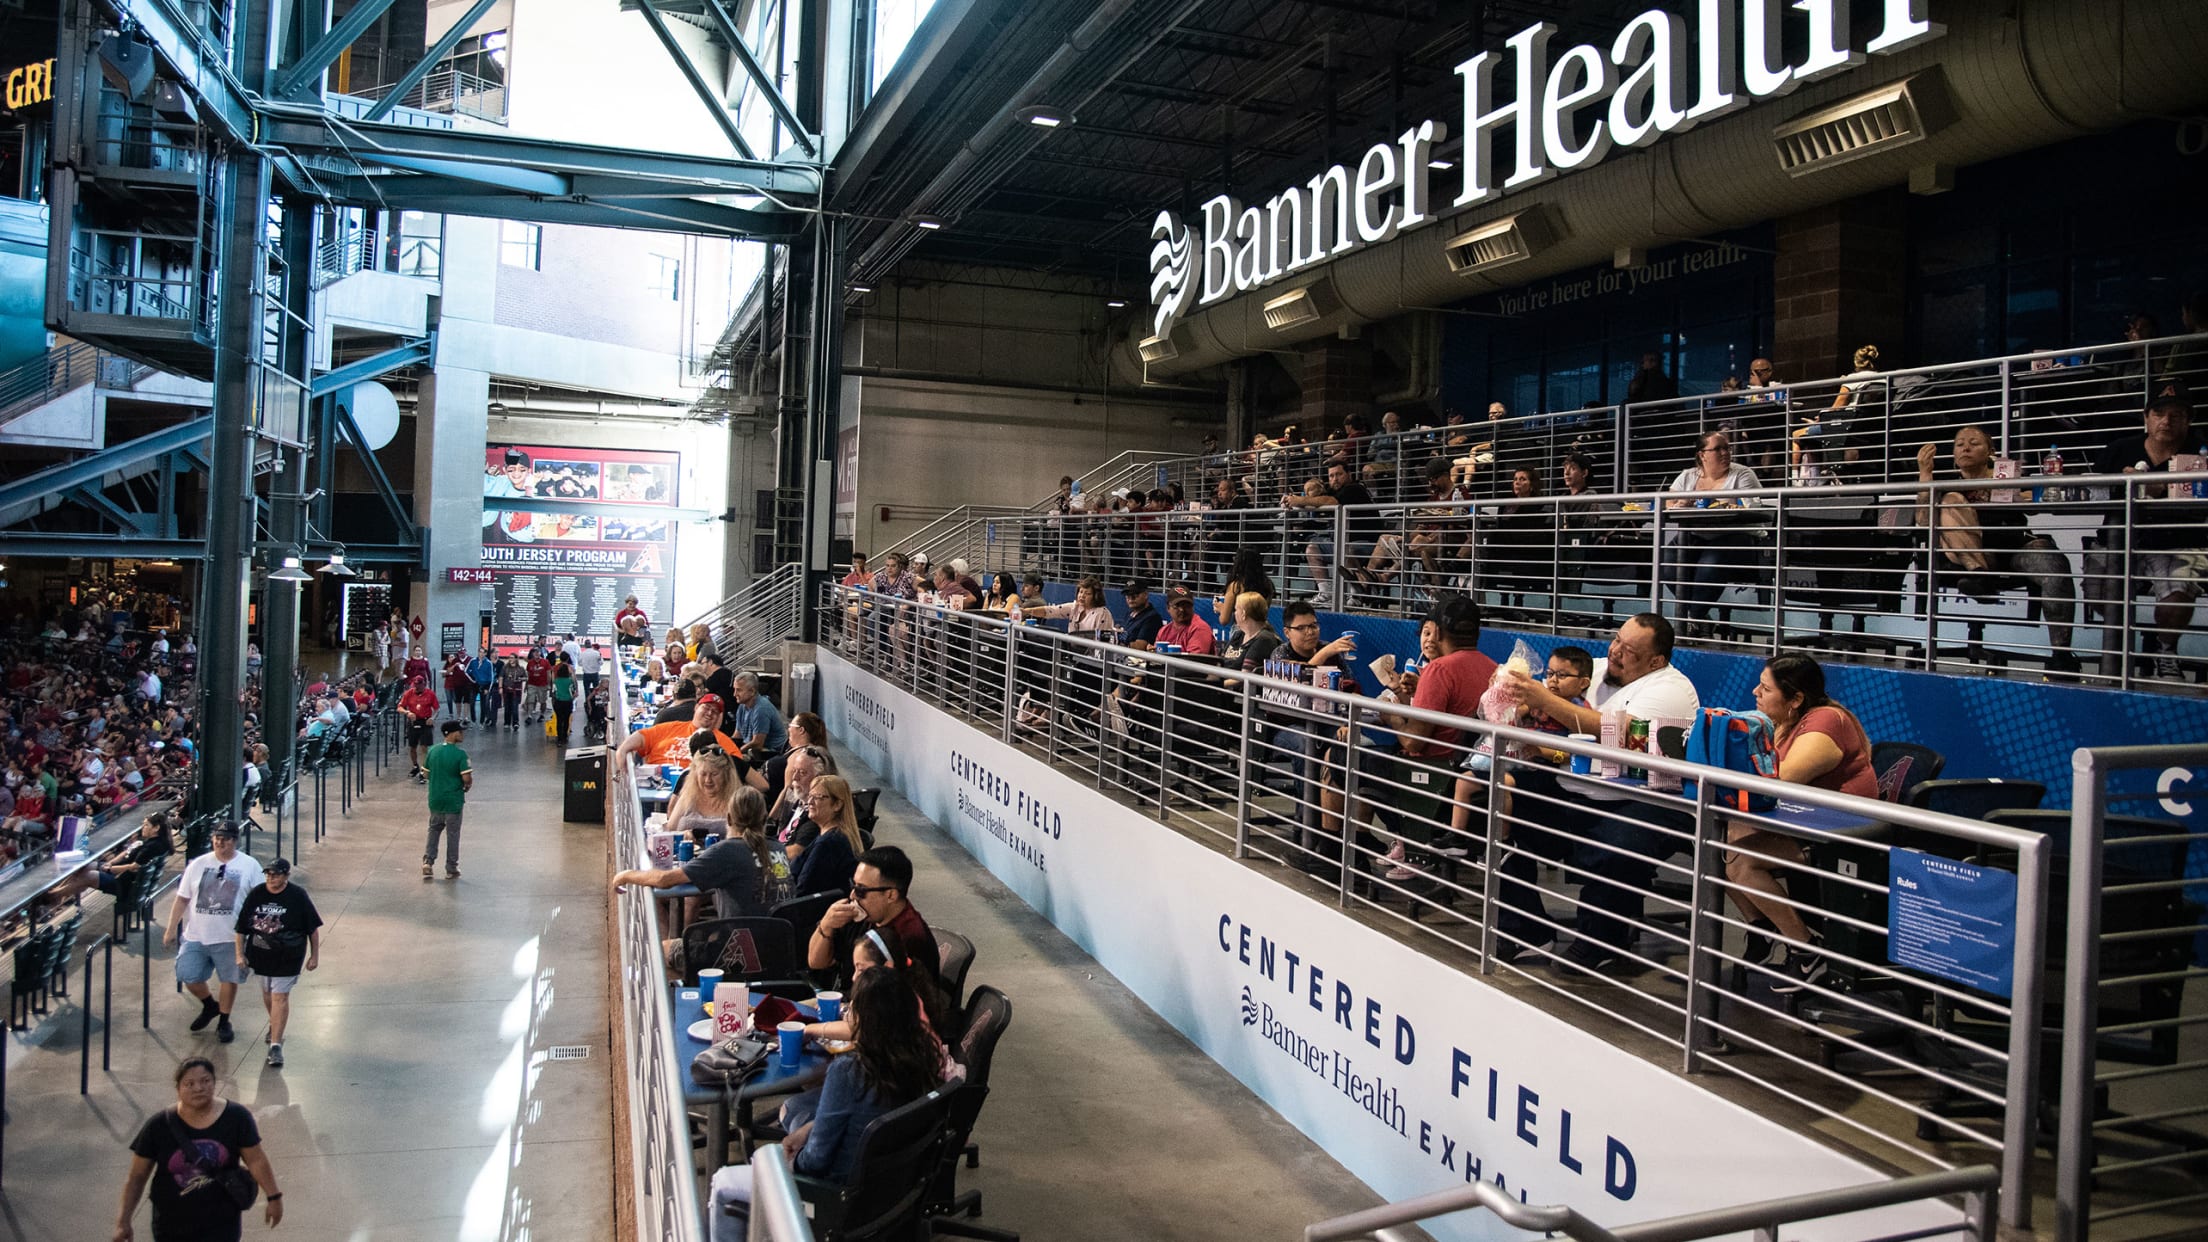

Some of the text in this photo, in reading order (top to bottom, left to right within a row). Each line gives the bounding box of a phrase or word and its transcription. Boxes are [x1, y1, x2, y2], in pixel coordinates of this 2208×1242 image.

[1199, 119, 1437, 305] Banner
[1497, 245, 1748, 316] You're here for your team.
[453, 569, 492, 582] 142-144
[517, 548, 563, 562] JERSEY
[566, 549, 627, 563] PROGRAM
[845, 684, 895, 731] CENTERED FIELD
[951, 750, 1061, 840] CENTERED FIELD
[964, 794, 986, 827] Banner
[986, 809, 1007, 844] Health
[1896, 876, 1918, 890] Rules
[717, 1013, 736, 1025] POP
[720, 1020, 742, 1034] CORN
[1218, 913, 1637, 1201] CENTERED FIELD
[1261, 1001, 1329, 1079] Banner
[1332, 1049, 1408, 1139] Health
